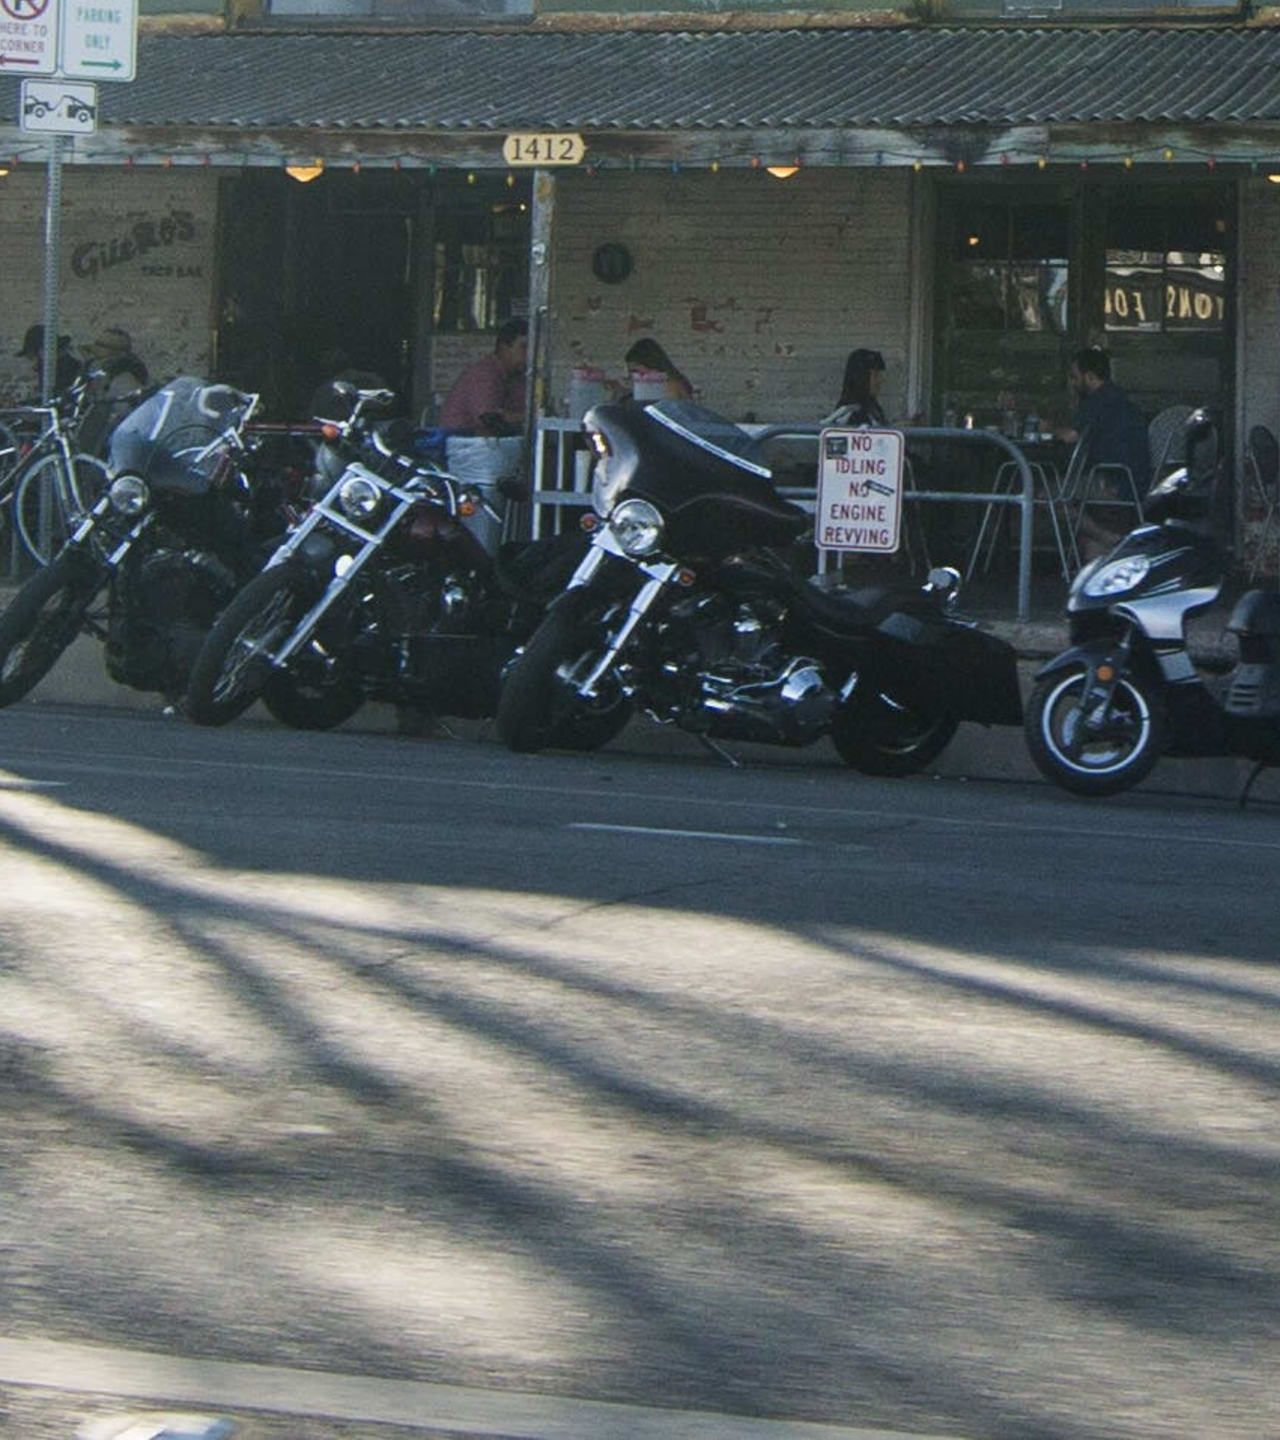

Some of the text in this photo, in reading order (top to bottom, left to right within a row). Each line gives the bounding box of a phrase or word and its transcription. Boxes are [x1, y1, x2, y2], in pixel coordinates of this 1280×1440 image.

[76, 6, 122, 25] PARKING
[34, 24, 48, 38] TO
[0, 38, 46, 54] CORNER
[84, 33, 112, 51] ONLY
[511, 137, 575, 161] 1412
[851, 435, 873, 452] NO
[835, 458, 887, 476] IDLING
[849, 481, 871, 498] NO
[830, 503, 887, 522] ENGINE
[824, 526, 889, 546] REVVING
